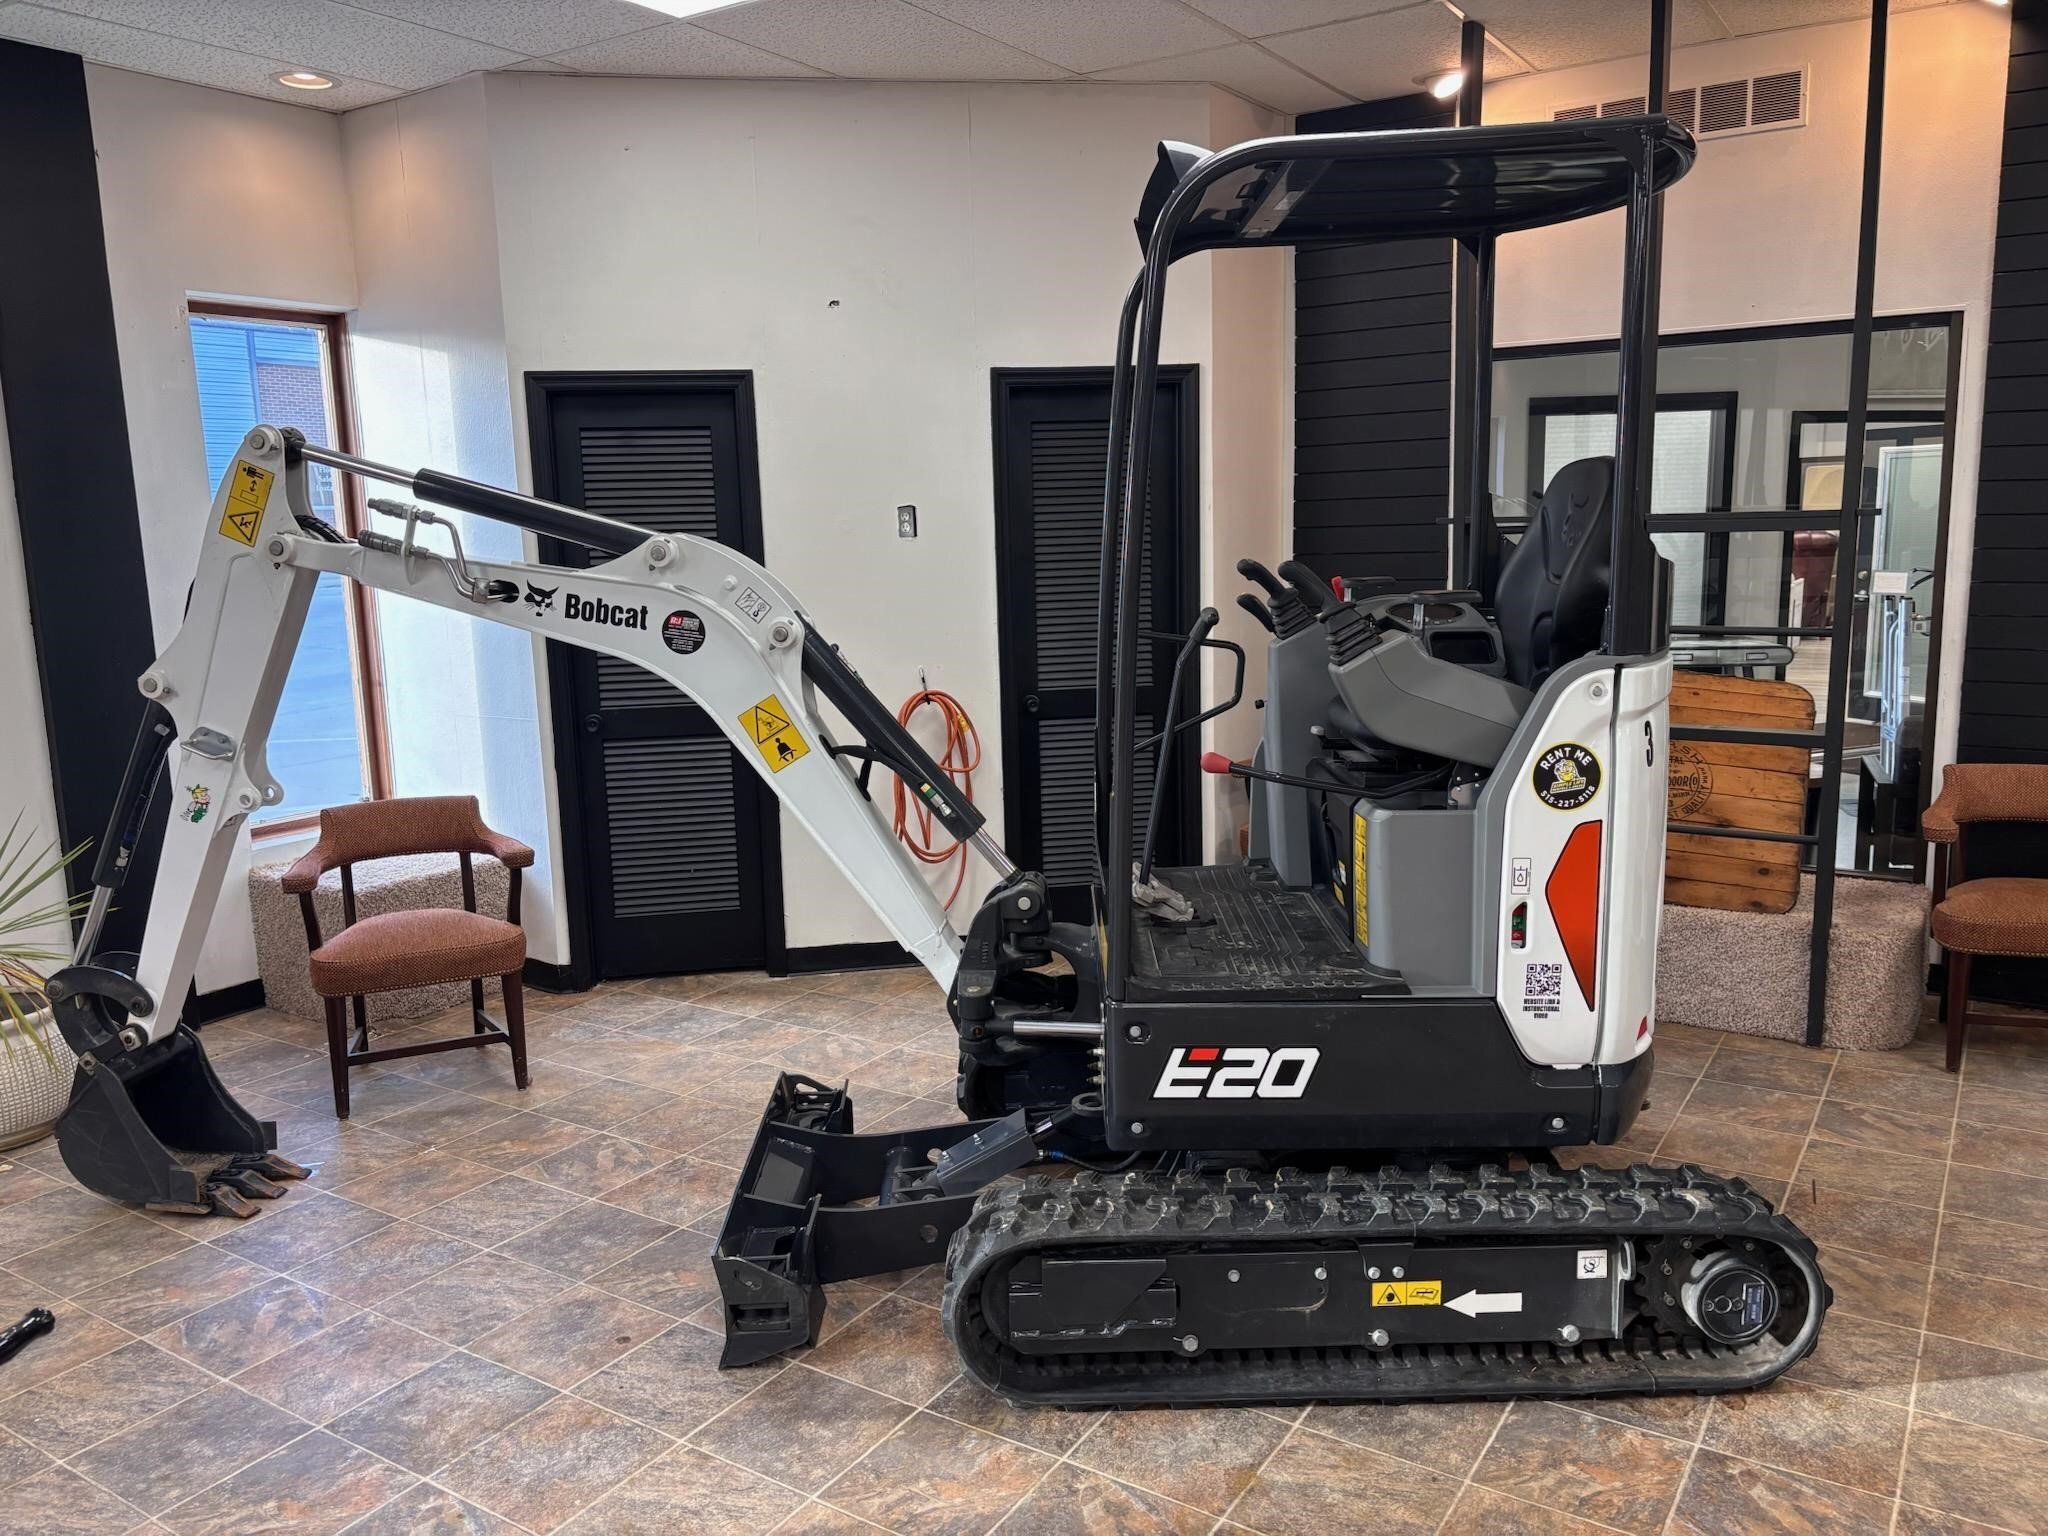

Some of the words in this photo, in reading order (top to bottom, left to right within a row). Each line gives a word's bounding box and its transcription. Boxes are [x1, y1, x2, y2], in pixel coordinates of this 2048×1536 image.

[564, 593, 648, 630] Bobcat
[1540, 747, 1571, 770] RENT
[1573, 749, 1592, 766] ME
[1644, 720, 1654, 767] 3
[1540, 786, 1595, 808] 515-227-5118
[1681, 784, 1712, 814] QUALITY
[1152, 1047, 1321, 1099] E20
